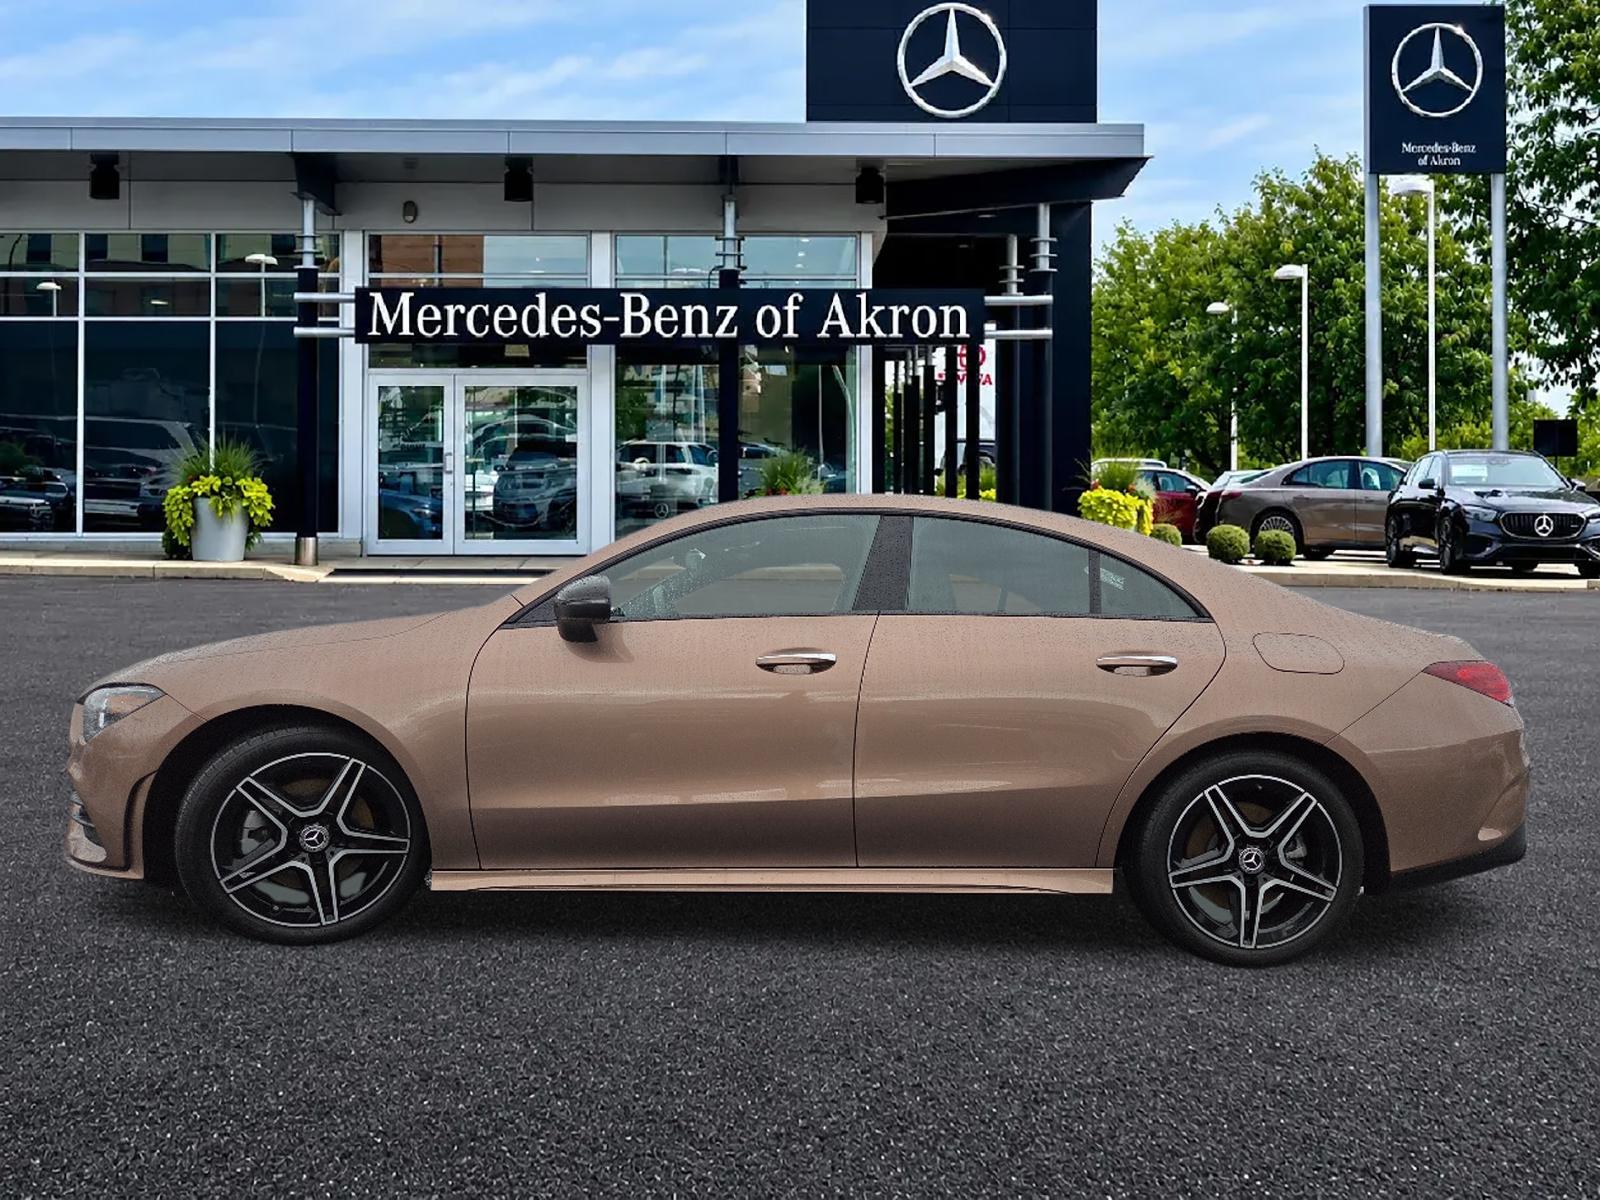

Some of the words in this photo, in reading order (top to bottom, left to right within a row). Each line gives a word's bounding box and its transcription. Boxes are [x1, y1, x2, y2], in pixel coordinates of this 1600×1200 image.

[1401, 141, 1477, 154] Mercedes-Benz
[1417, 155, 1428, 166] of
[1430, 155, 1461, 166] Akron
[367, 291, 738, 339] Mercedes-Benz
[755, 292, 804, 339] of
[816, 292, 971, 339] Akron
